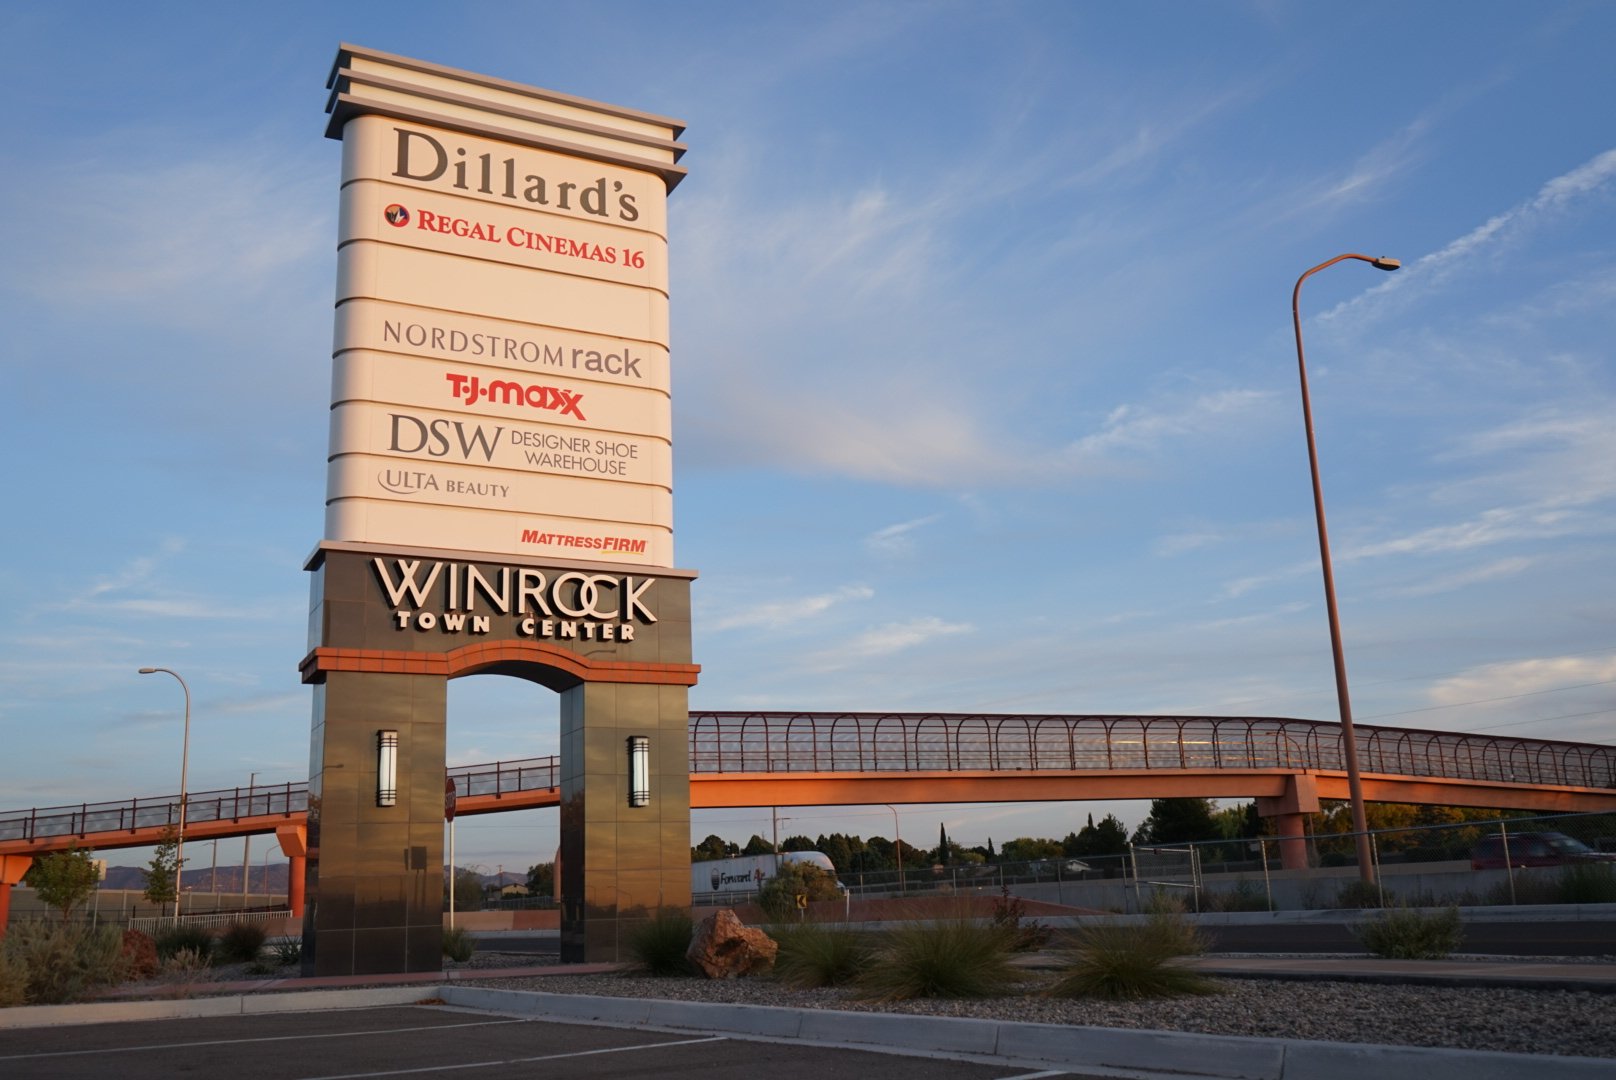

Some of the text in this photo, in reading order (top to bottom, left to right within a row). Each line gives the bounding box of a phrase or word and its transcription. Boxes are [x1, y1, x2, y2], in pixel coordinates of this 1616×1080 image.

[392, 127, 640, 222] Dillard's
[417, 209, 645, 269] REGAL CINEMAS 16
[383, 319, 642, 378] NORDSTROM rack
[387, 413, 638, 462] DSW DESIGNER SHOE
[524, 450, 627, 476] WAREHOUSE
[386, 469, 510, 498] ULTA BEAUTY
[372, 557, 658, 623] WINROCK
[396, 610, 635, 641] TOWN CENTER
